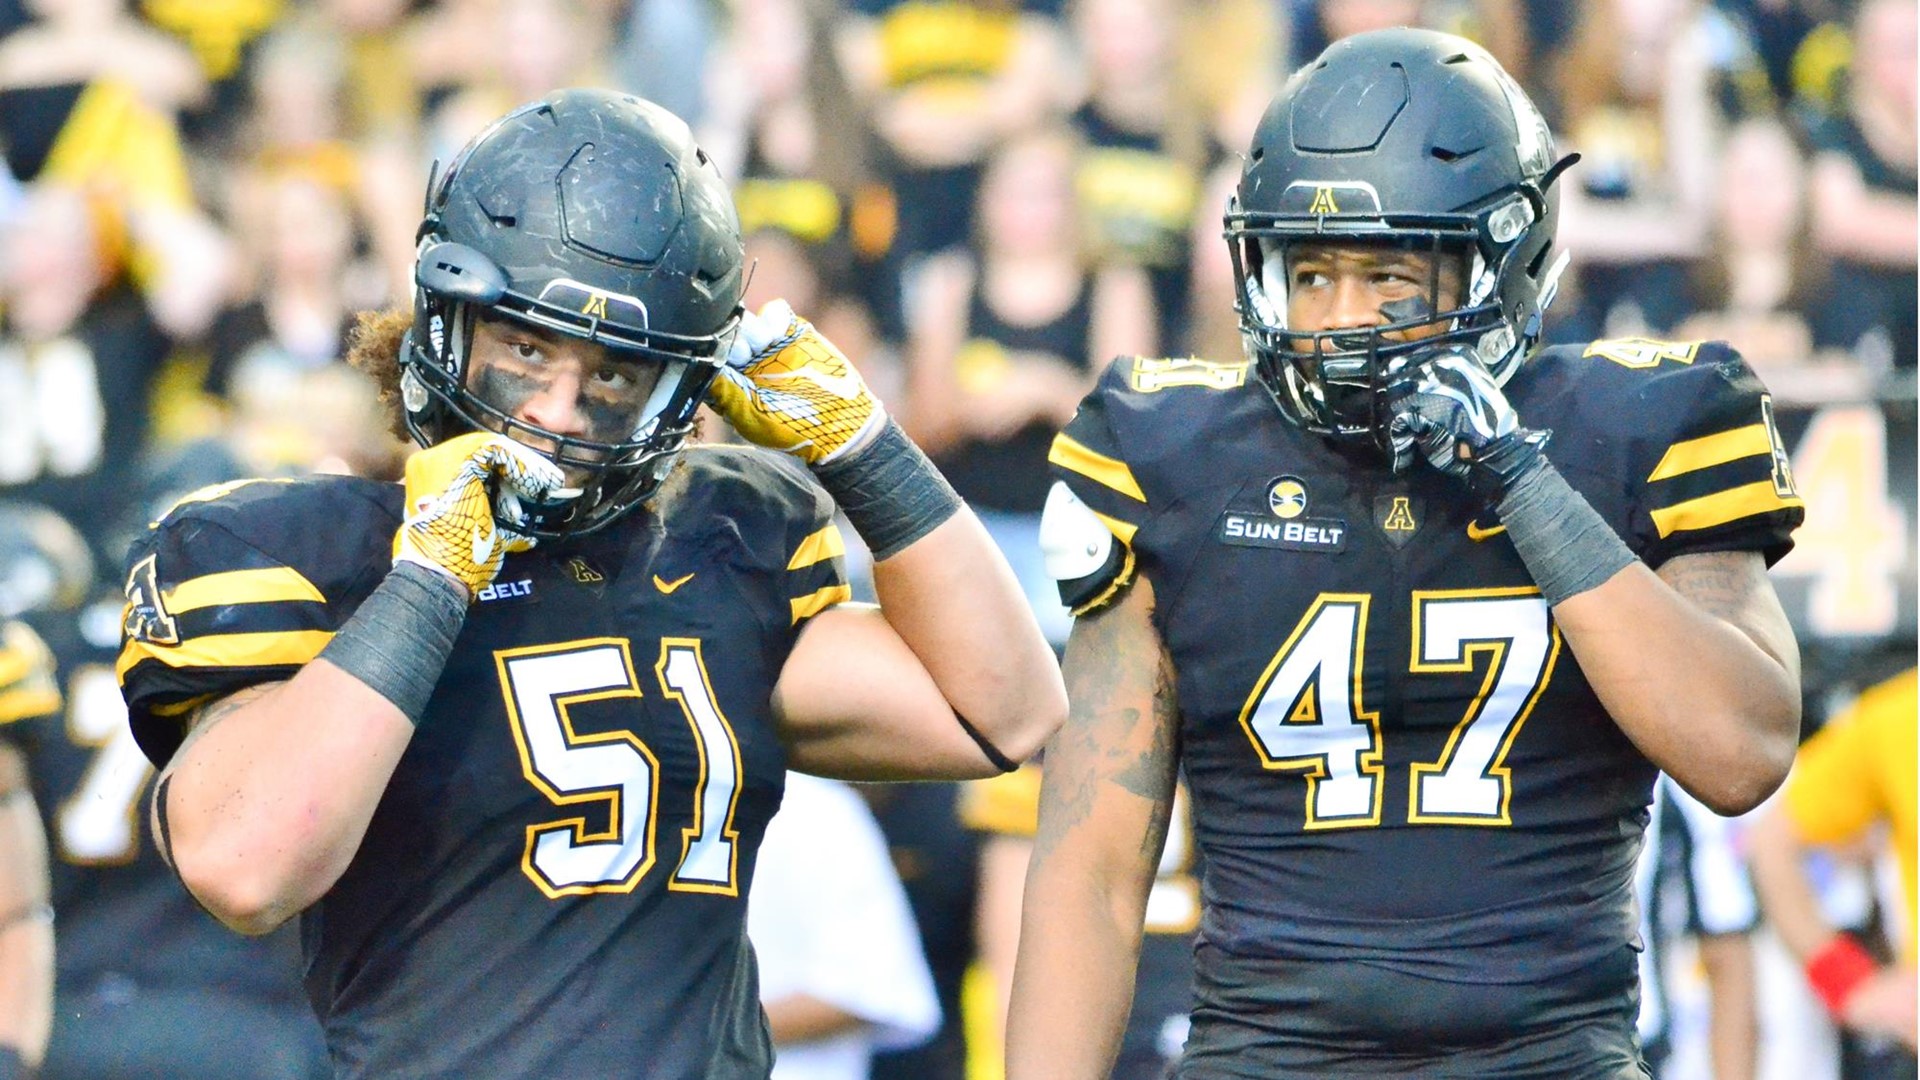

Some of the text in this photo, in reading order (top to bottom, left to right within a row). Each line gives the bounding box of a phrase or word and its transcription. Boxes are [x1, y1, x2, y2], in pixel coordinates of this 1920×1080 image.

[1309, 186, 1338, 214] A
[581, 291, 608, 320] A
[1385, 498, 1415, 530] A
[1225, 517, 1343, 545] SUN BELT
[569, 559, 603, 582] A
[124, 553, 179, 643] A
[1238, 586, 1561, 829] 47
[493, 637, 743, 898] 51
